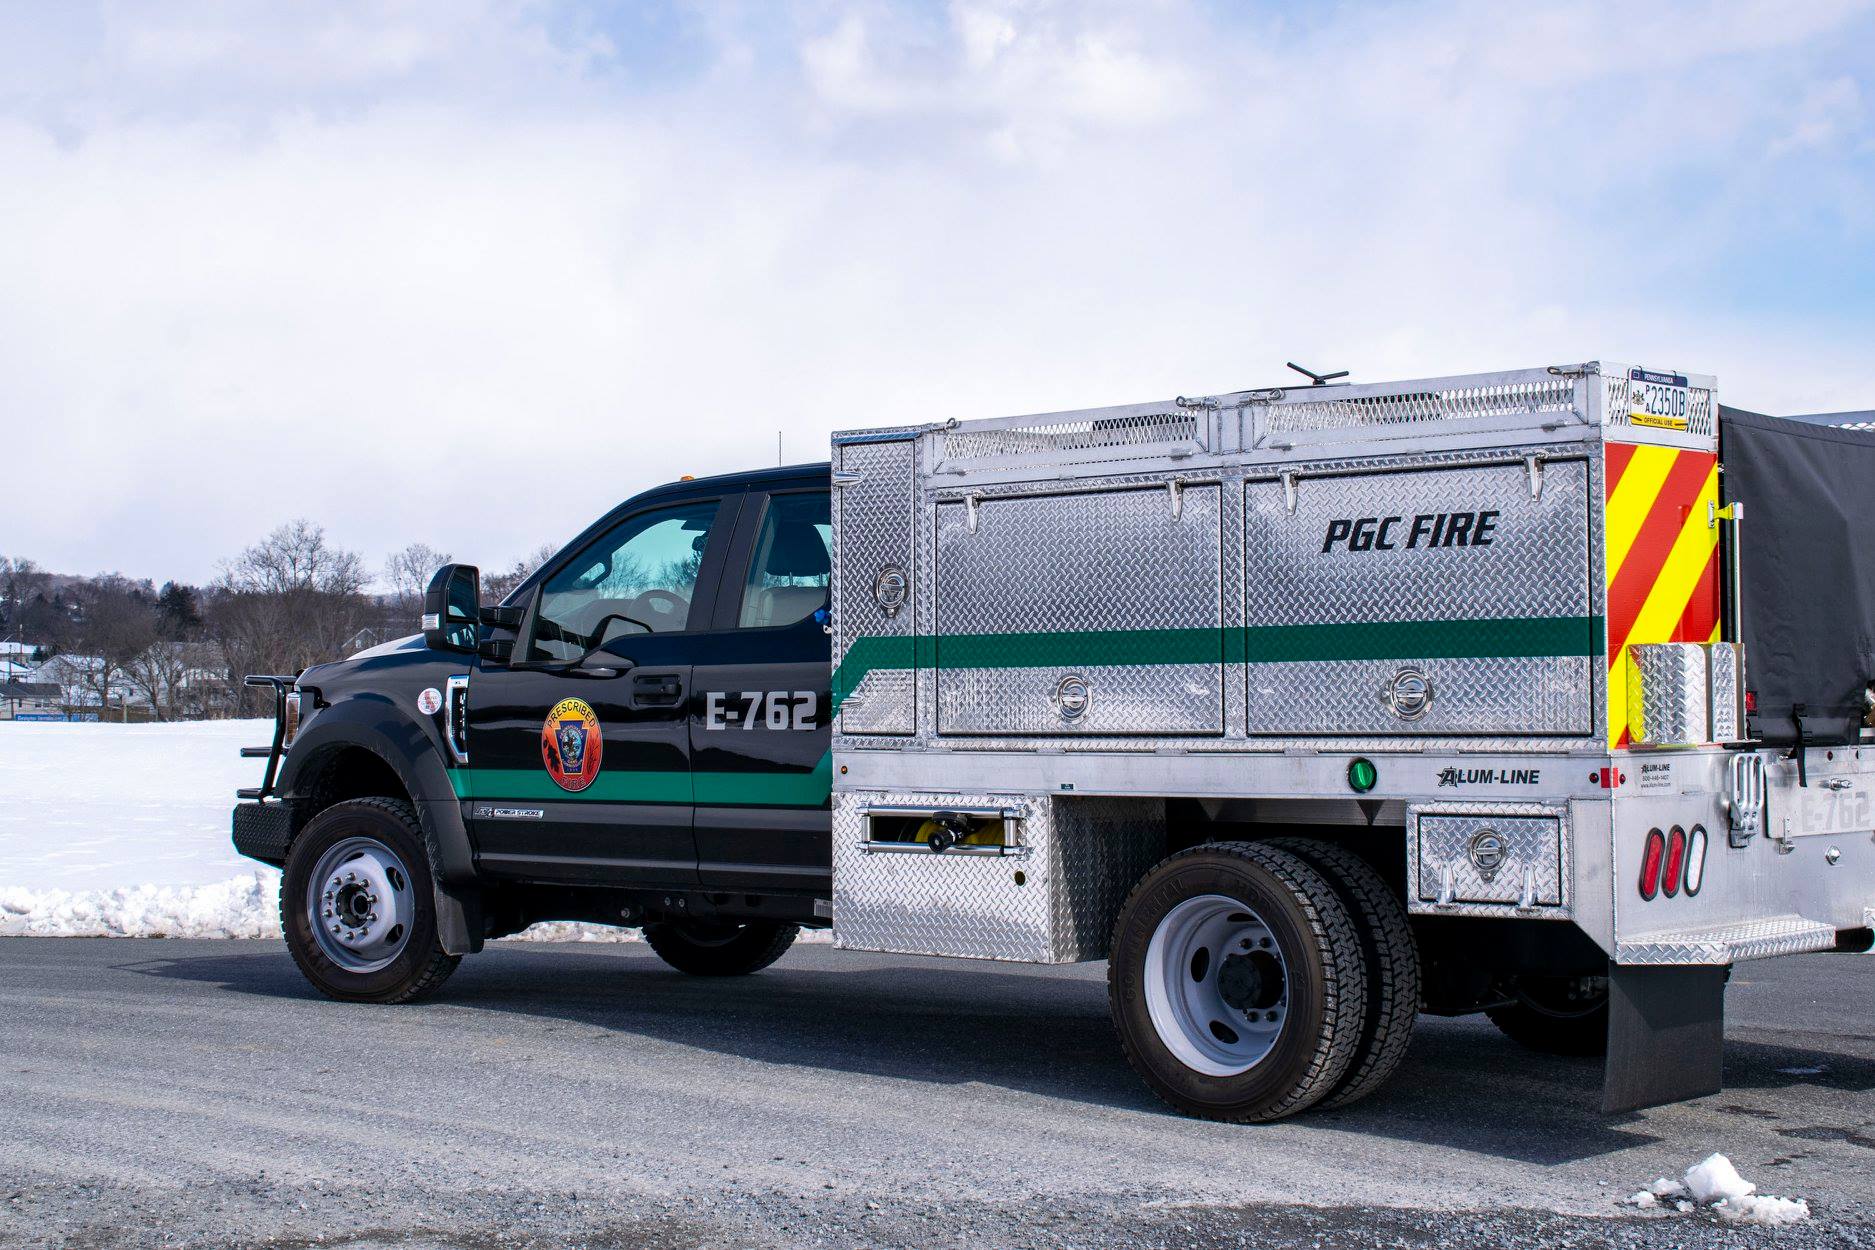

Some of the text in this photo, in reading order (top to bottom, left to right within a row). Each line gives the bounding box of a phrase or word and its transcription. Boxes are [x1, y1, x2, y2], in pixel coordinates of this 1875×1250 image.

[1643, 417, 1661, 425] OFFICIAL
[1321, 510, 1500, 553] PGC FIRE
[546, 701, 596, 728] PRESCRIBED
[706, 691, 817, 731] E-762
[1436, 766, 1540, 788] ALUM-LINE
[1641, 763, 1670, 773] ALUM-LINE
[1801, 791, 1871, 832] E-762
